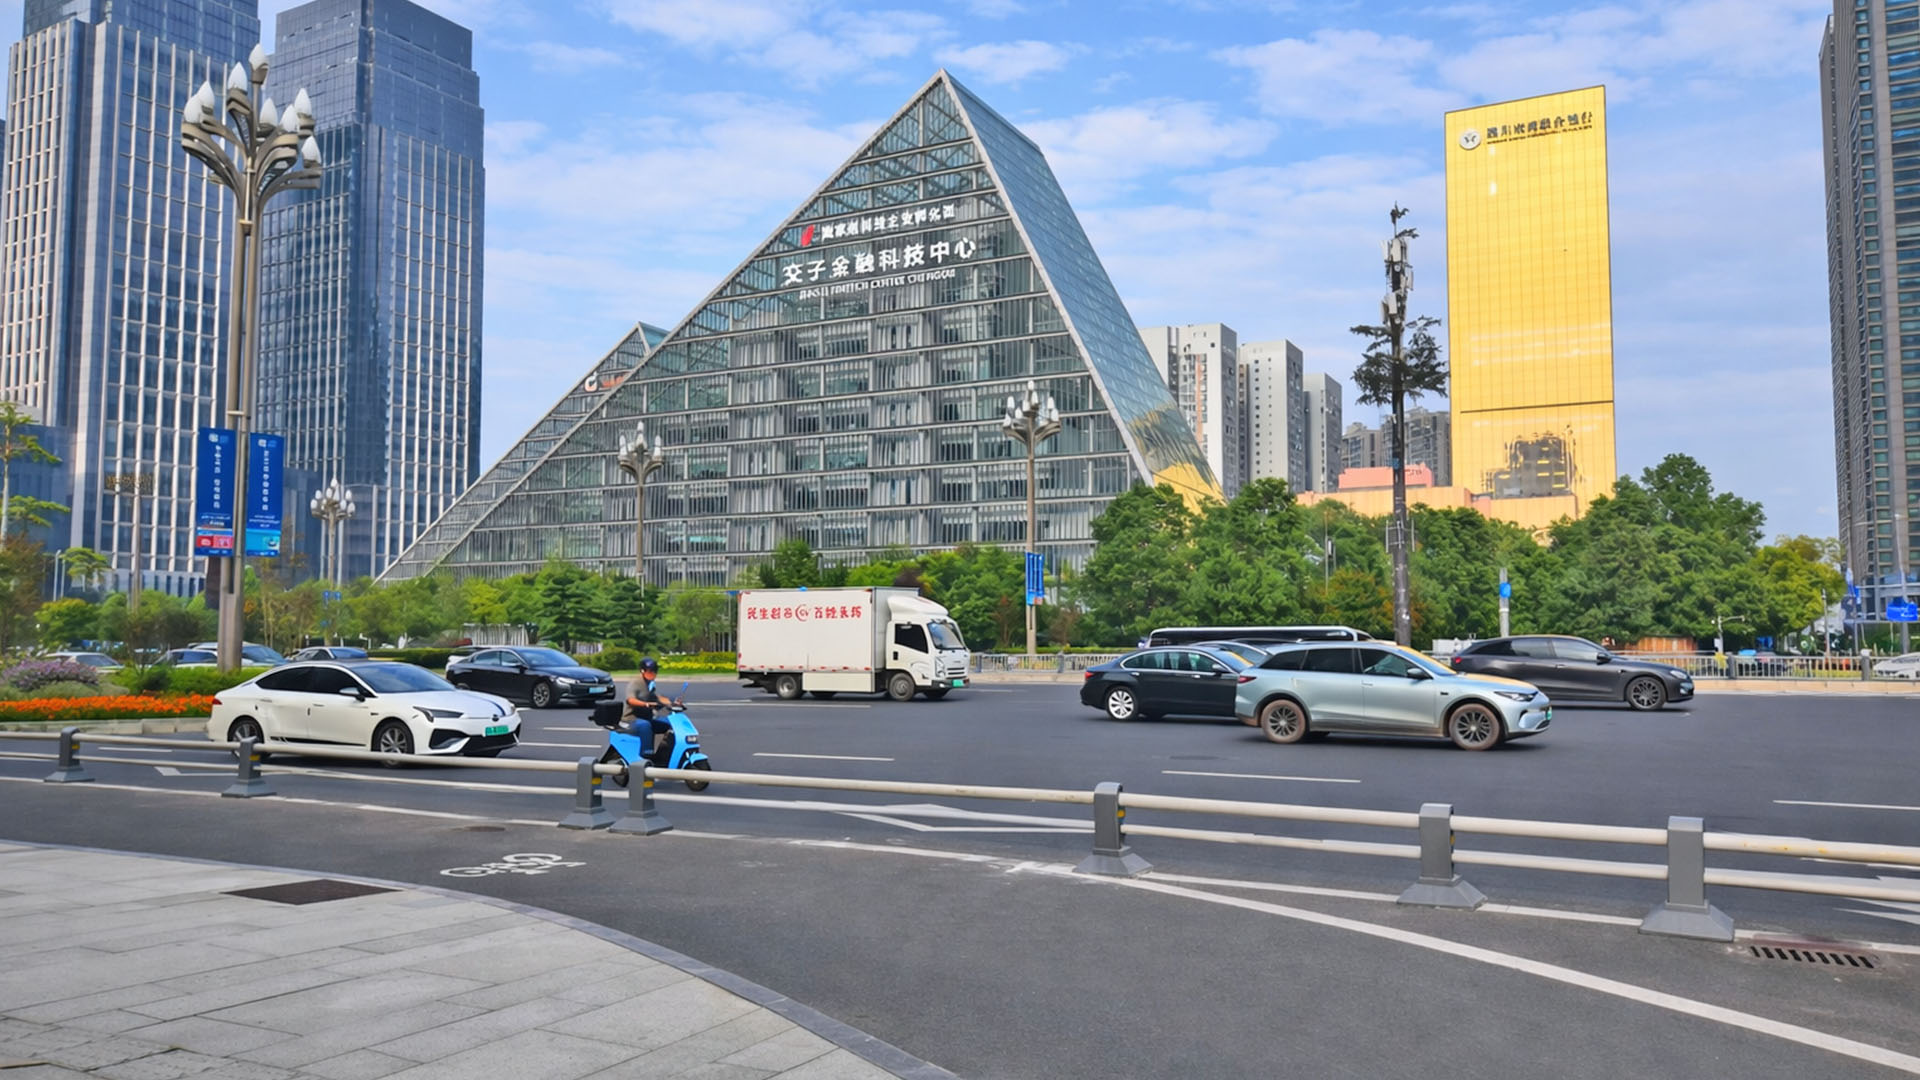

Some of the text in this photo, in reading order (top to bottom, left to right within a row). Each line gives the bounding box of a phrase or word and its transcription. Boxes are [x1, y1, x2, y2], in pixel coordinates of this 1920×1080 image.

[781, 237, 977, 288] 交子金融科技中心
